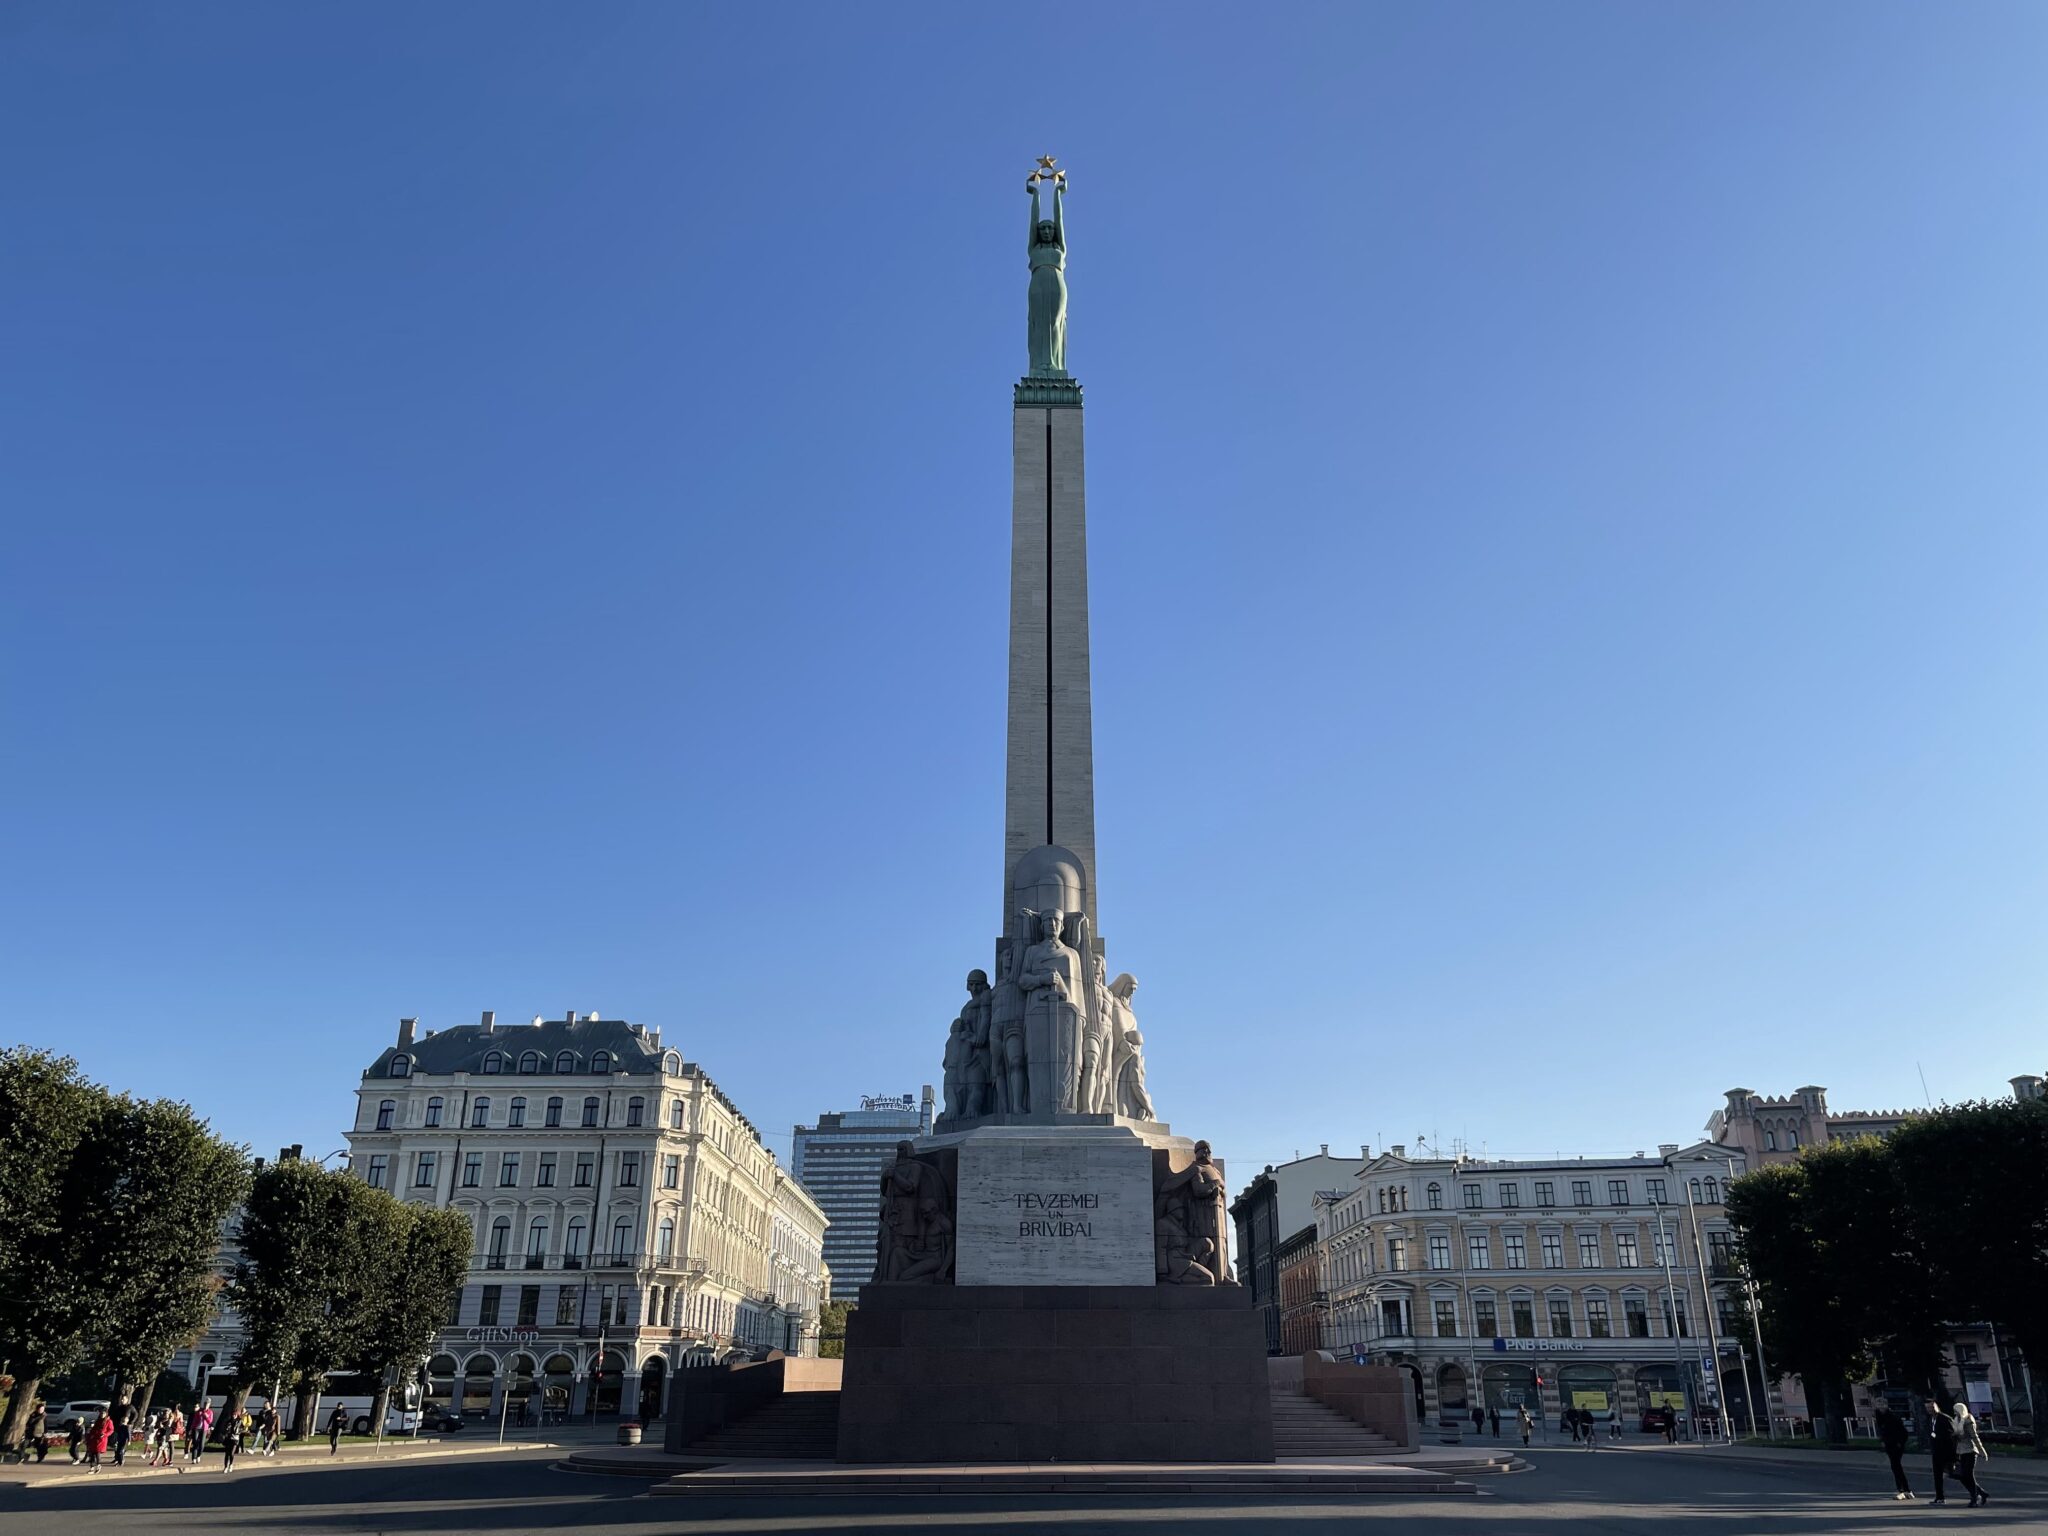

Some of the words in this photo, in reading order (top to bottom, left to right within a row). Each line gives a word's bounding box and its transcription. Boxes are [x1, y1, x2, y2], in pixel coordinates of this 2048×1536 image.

[1048, 1210, 1064, 1220] UN
[1505, 1338, 1536, 1351] PNB
[1539, 1338, 1584, 1351] Banka
[1705, 1358, 1713, 1369] P
